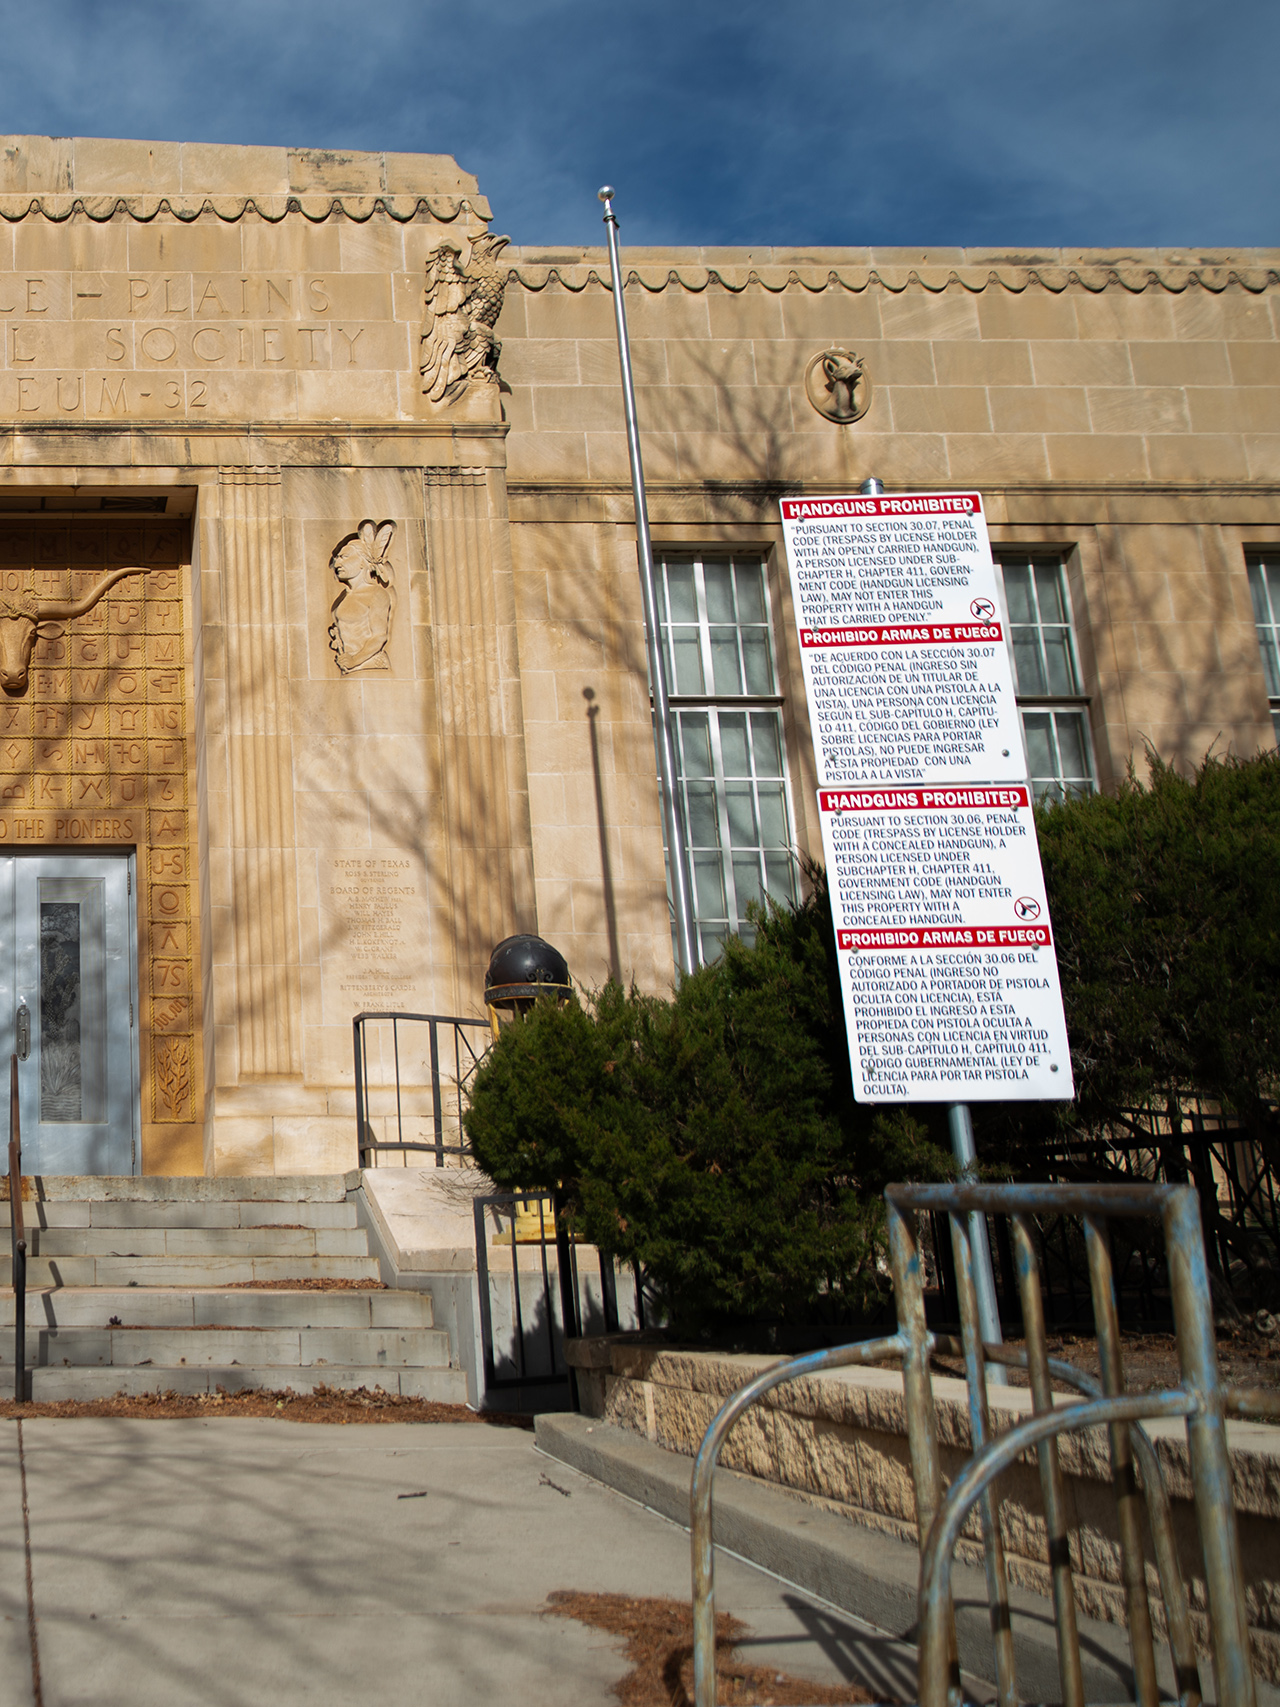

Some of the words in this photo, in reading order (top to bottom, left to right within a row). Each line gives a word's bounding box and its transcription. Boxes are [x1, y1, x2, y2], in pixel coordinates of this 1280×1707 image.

[128, 278, 330, 313] PLAINS
[106, 327, 365, 363] SOCIETY
[788, 501, 877, 516] HANDGUNS
[879, 497, 974, 513] PROHIBITED
[850, 523, 863, 533] TO
[865, 522, 908, 532] SECTION
[942, 520, 974, 530] PENAL
[792, 536, 820, 546] CODE
[822, 534, 877, 546] (TRESPASS
[878, 533, 891, 543] BY
[893, 532, 935, 542] LICENSE
[936, 530, 977, 541] HOLDER
[793, 547, 819, 557] WITH
[821, 547, 836, 556] AN
[837, 545, 875, 556] OPENLY
[877, 544, 921, 554] CARRIED
[795, 559, 803, 568] A
[804, 558, 846, 568] PERSON
[847, 556, 896, 567] LICENSED
[898, 555, 934, 565] UNDER
[935, 554, 959, 564] SUB-
[797, 569, 843, 580] CHAPTER
[857, 567, 904, 578] CHAPTER
[929, 565, 973, 575] GOVERN-
[798, 581, 826, 591] MENT
[829, 580, 857, 590] CODE
[859, 578, 914, 590] (HANDGUN
[915, 576, 969, 587] LICENSING
[830, 592, 852, 601] MAY
[854, 591, 874, 601] NOT
[876, 590, 909, 600] ENTER
[910, 589, 933, 598] THIS
[801, 603, 853, 614] PROPERTY
[855, 602, 881, 612] WITH
[883, 602, 891, 611] A
[892, 600, 943, 611] HANDGUN
[803, 615, 826, 625] THAT
[829, 615, 840, 624] IS
[841, 613, 886, 624] CARRIED
[803, 629, 878, 644] PROHIBIDO
[881, 628, 930, 641] ARMAS
[932, 627, 952, 639] DE
[953, 626, 999, 639] FUEGO
[826, 792, 919, 807] HANDGUNS
[921, 791, 1021, 806] PROHIBITED
[830, 816, 885, 827] PURSUANT
[888, 816, 901, 826] TO
[903, 815, 948, 826] SECTION
[985, 814, 1019, 824] PENAL
[14, 818, 45, 839] THE
[56, 818, 134, 839] PIONEERS
[831, 829, 860, 839] CODE
[863, 827, 921, 840] (TRESPASS
[922, 827, 936, 837] BY
[938, 826, 982, 837] LICENSE
[983, 826, 1026, 836] HOLDER
[334, 860, 362, 868] STATE
[364, 860, 377, 868] OF
[380, 860, 410, 868] TEXAS
[329, 887, 360, 895] BOARD
[362, 887, 373, 895] OF
[376, 887, 416, 895] REGENTS
[841, 931, 919, 946] PROHIBIDO
[922, 930, 973, 944] ARMAS
[976, 930, 996, 943] DE
[998, 929, 1046, 943] FUEGO
[847, 955, 907, 966] CONFORME
[910, 955, 918, 965] A
[919, 954, 934, 965] LA
[935, 950, 982, 965] SECCIÓN
[984, 953, 1016, 964] 30.06
[1017, 952, 1038, 963] DEL
[849, 965, 891, 979] CÓDIGO
[893, 967, 927, 978] PENAL
[929, 966, 980, 979] (INGRESO
[982, 966, 999, 976] NO
[851, 980, 918, 992] AUTORIZADO
[920, 980, 928, 990] A
[929, 979, 987, 990] PORTADOR
[988, 978, 1003, 989] DE
[1005, 978, 1050, 989] PISTOLA
[852, 993, 893, 1005] OCULTA
[894, 993, 918, 1004] CON
[976, 988, 1003, 1002] ESTÁ
[854, 1006, 913, 1017] PROHIBIDO
[915, 1006, 927, 1016] EL
[929, 1005, 978, 1016] INGRESO
[979, 1004, 988, 1015] A
[989, 1004, 1016, 1015] ESTA
[855, 1019, 909, 1030] PROPIEDA
[910, 1018, 934, 1029] CON
[936, 1017, 980, 1029] PISTOLA
[982, 1017, 1023, 1028] OCULTA
[1024, 1016, 1032, 1027] A
